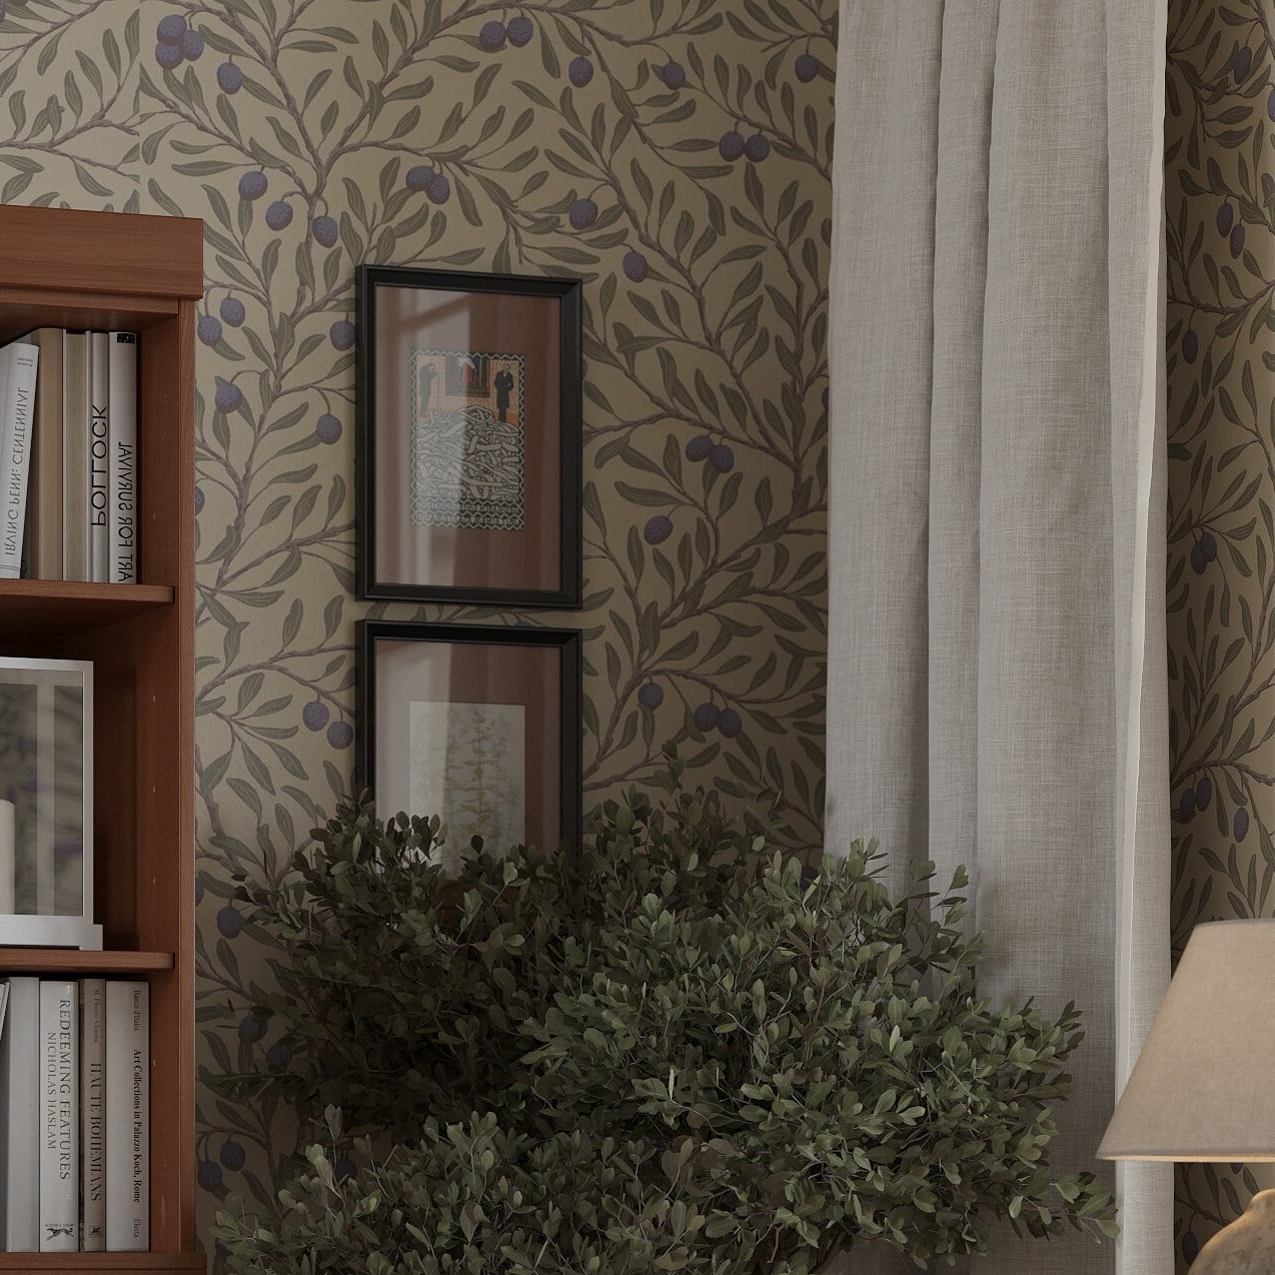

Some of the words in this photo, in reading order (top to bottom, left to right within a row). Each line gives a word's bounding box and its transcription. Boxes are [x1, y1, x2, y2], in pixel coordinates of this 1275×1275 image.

[47, 1032, 56, 1095] NICHOLAS
[60, 1000, 70, 1094] REDEEMING
[133, 1049, 142, 1063] Art
[91, 1063, 101, 1112] HAUTE
[133, 1065, 142, 1110] Collections
[47, 1100, 56, 1149] HASLAM
[133, 1111, 142, 1119] in
[133, 1121, 142, 1152] Palazzo
[60, 1101, 70, 1179] FEATURES
[91, 1117, 101, 1201] BOHEMIANS
[132, 1154, 142, 1177] Koch,
[133, 1180, 142, 1202] Rome
